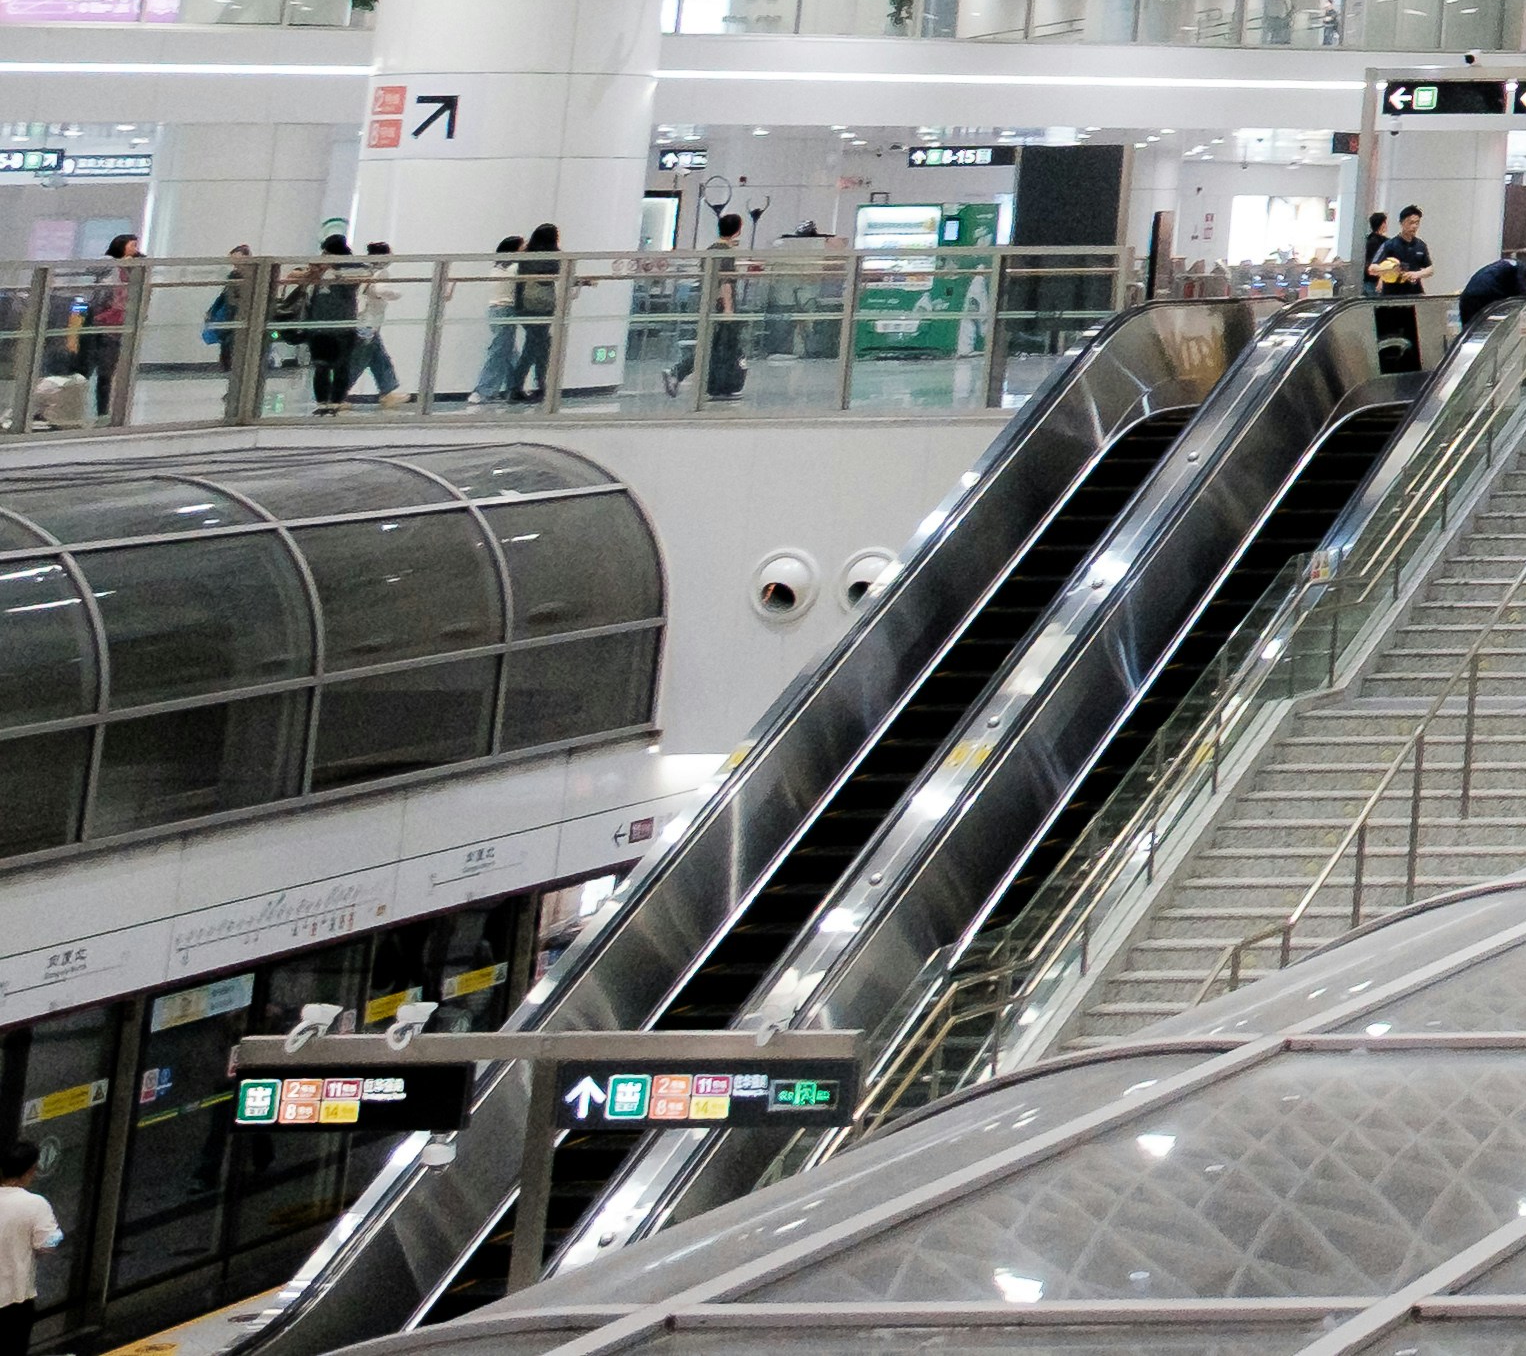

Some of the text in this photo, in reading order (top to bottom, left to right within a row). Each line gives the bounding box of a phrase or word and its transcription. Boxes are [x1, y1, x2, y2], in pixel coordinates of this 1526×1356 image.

[287, 1082, 301, 1097] 2
[328, 1082, 344, 1098] 11
[658, 1078, 671, 1094] 2
[698, 1077, 713, 1094] 11
[284, 1103, 297, 1120] 8
[656, 1099, 667, 1116] 8
